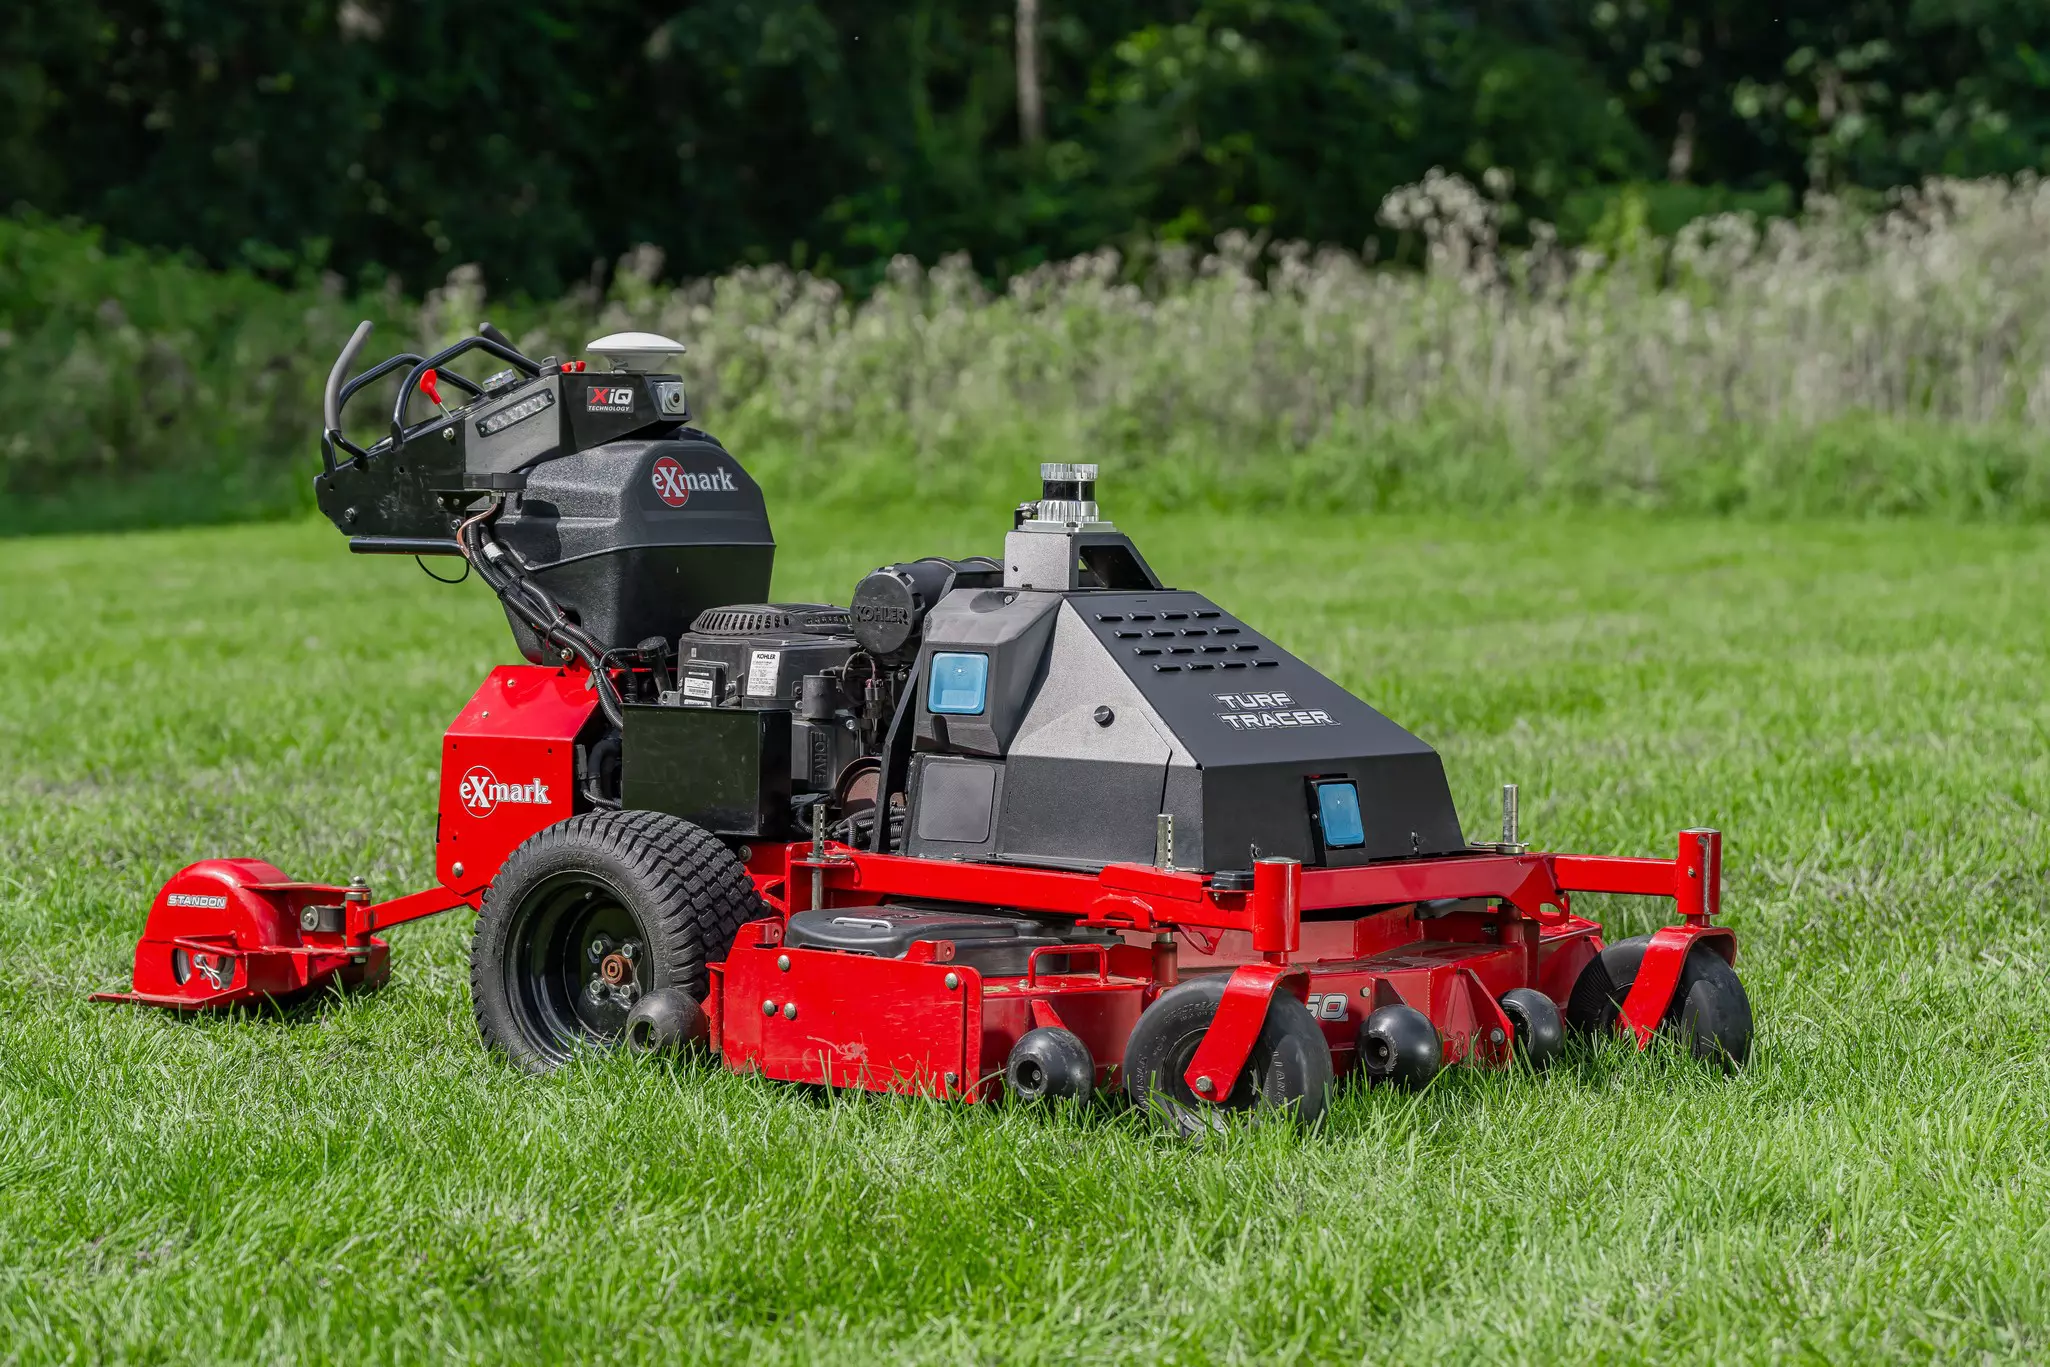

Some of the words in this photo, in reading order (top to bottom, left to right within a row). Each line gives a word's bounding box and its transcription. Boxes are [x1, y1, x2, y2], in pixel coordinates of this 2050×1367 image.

[652, 466, 737, 497] eXmark
[856, 605, 908, 624] KOHLER
[1217, 693, 1291, 708] TURF
[1220, 711, 1333, 728] TRACER
[460, 776, 551, 808] eXmark
[168, 894, 226, 908] STANDON
